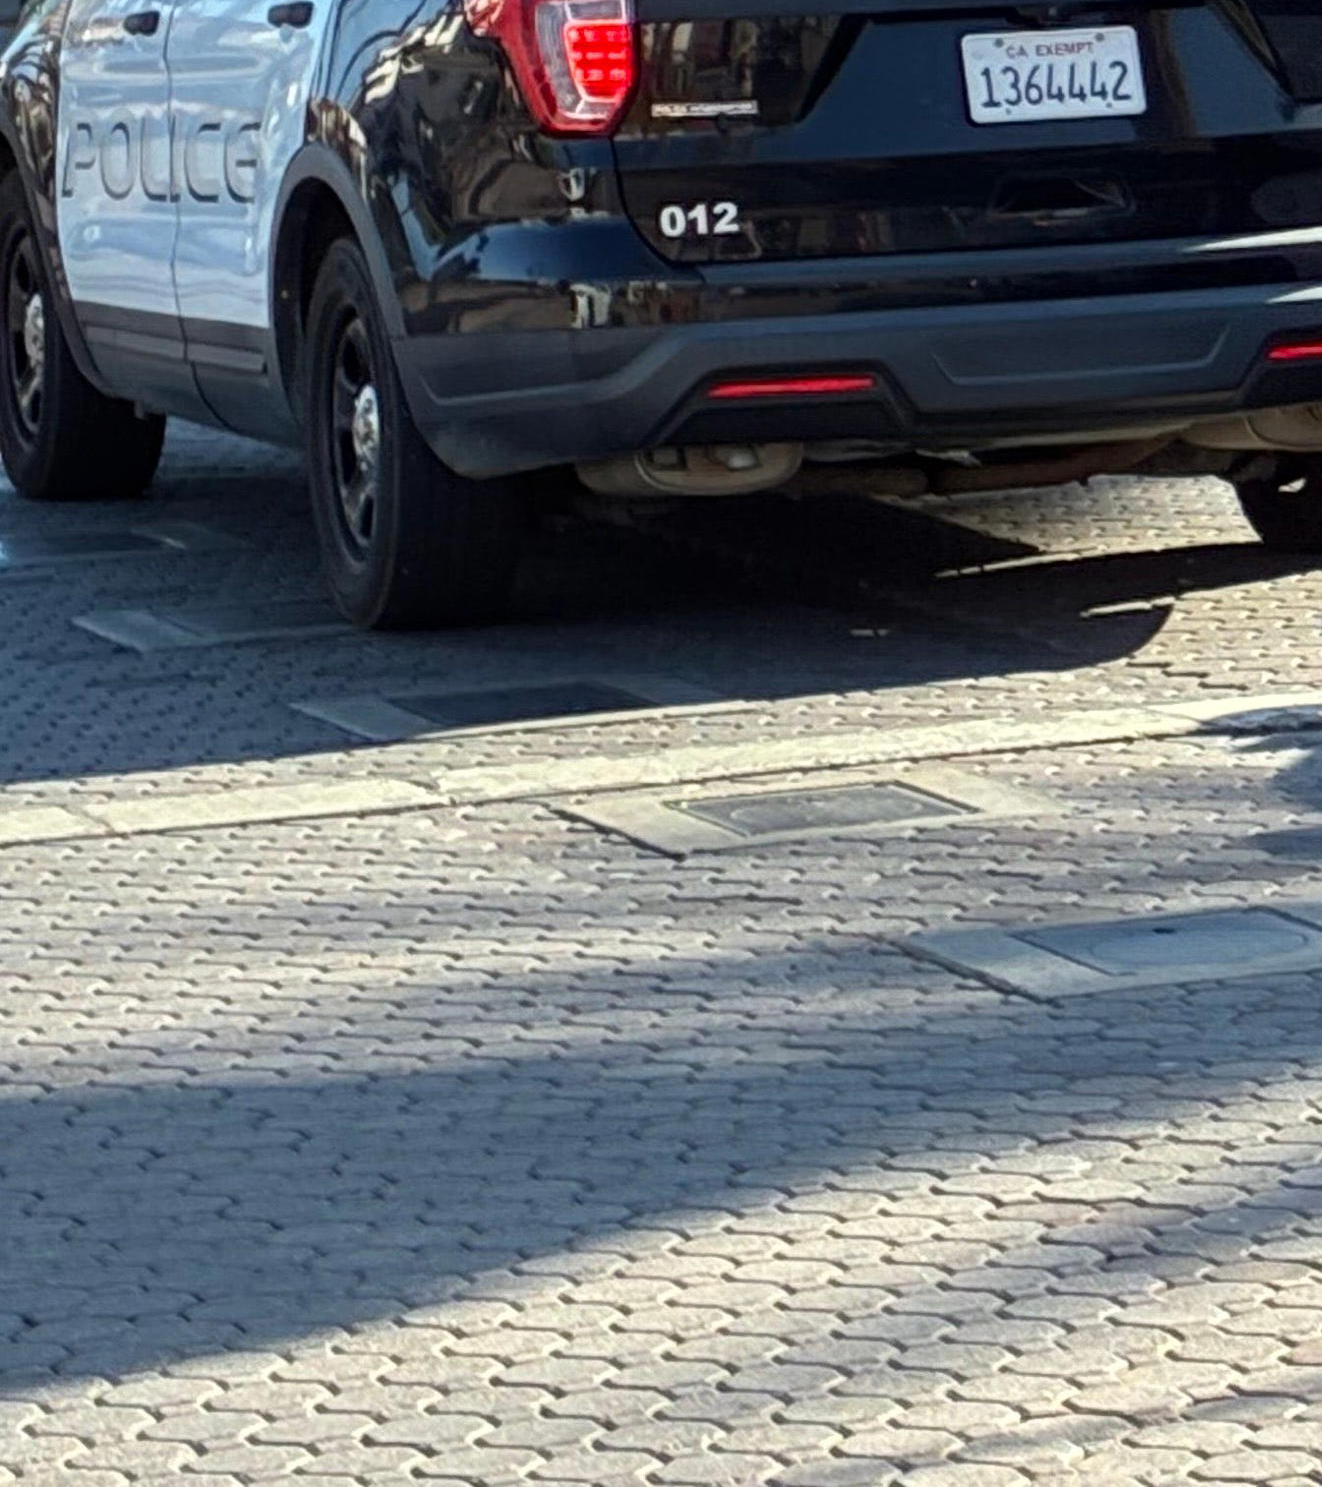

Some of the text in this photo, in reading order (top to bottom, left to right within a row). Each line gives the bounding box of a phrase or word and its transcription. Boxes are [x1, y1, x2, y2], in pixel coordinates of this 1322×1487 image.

[1036, 41, 1095, 58] EXEMPT
[980, 60, 1132, 109] 1364442
[61, 113, 261, 203] POLICE
[660, 201, 741, 238] 012
